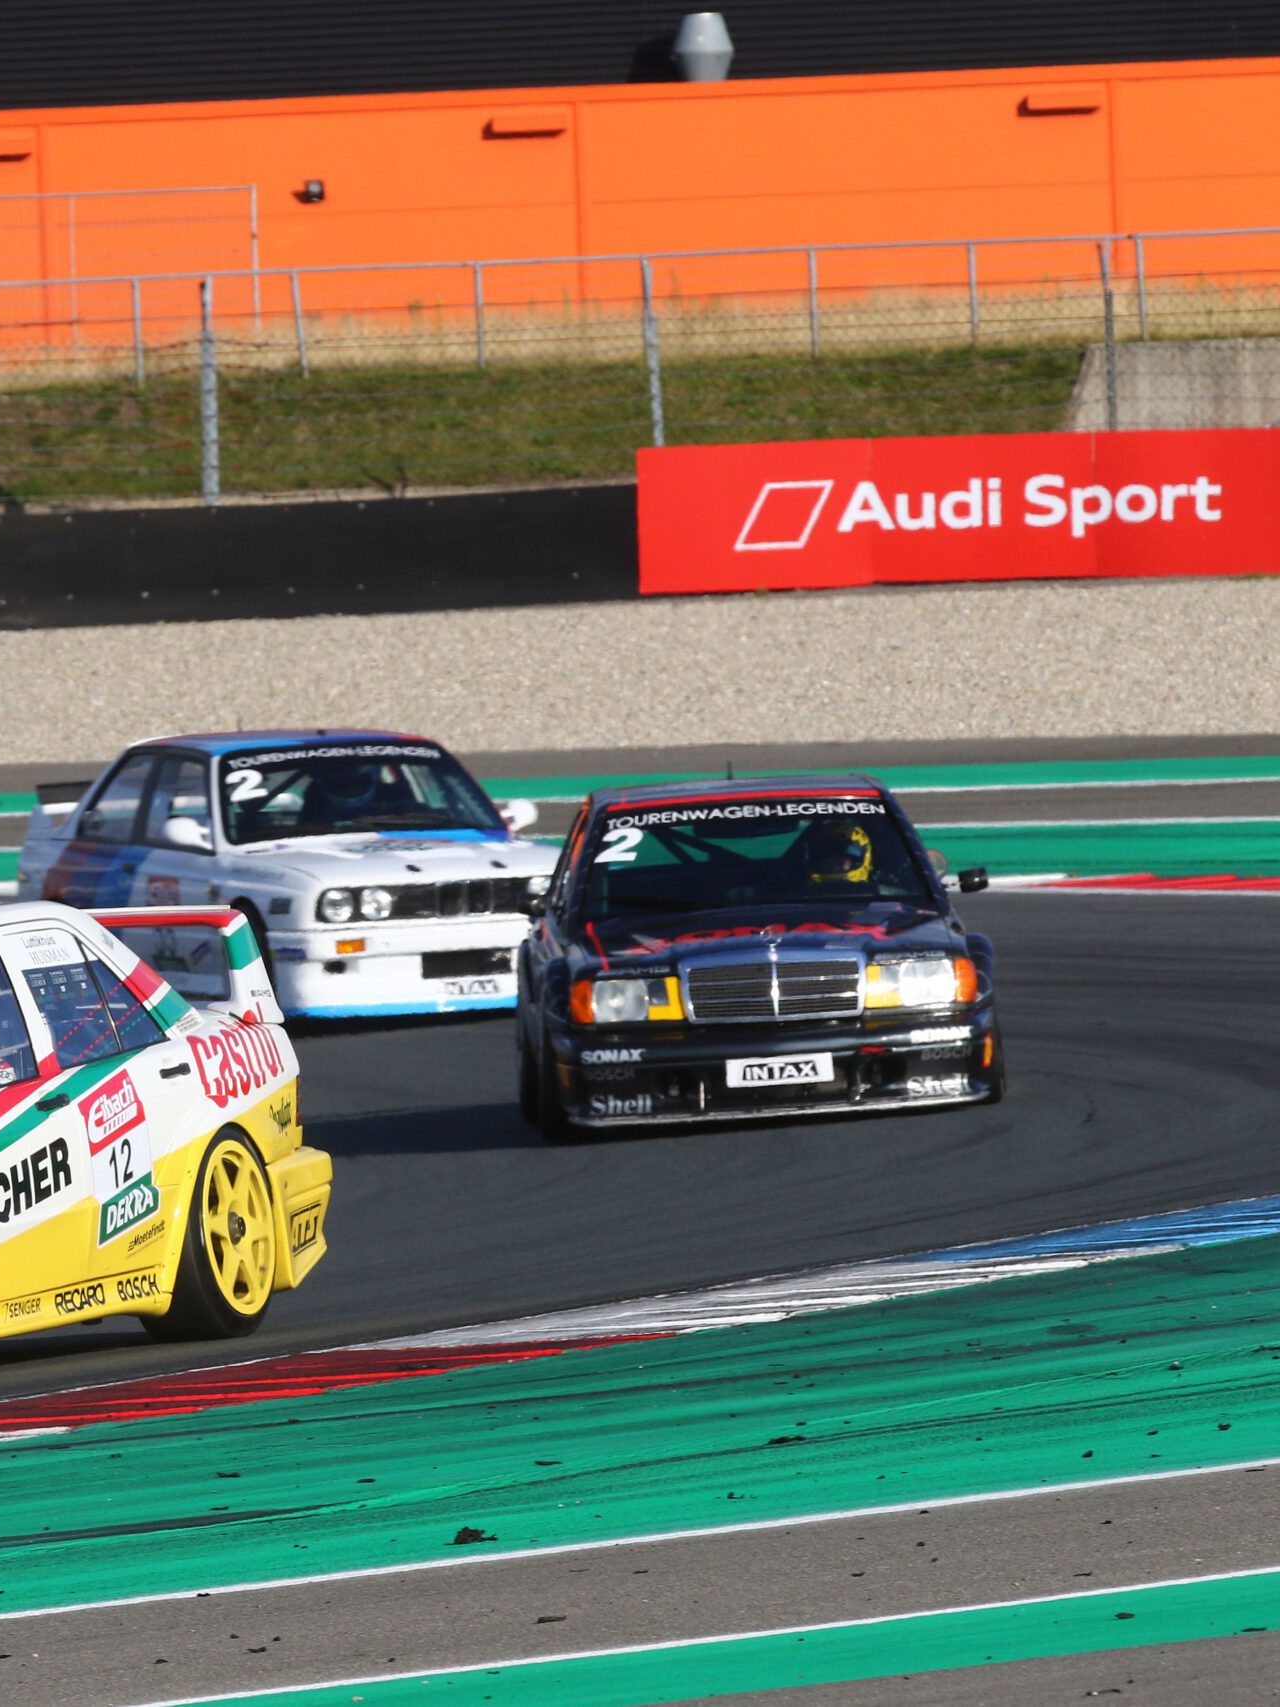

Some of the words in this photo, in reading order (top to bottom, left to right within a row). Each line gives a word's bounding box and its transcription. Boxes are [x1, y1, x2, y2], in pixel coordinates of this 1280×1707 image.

[837, 477, 1002, 533] Audi
[1024, 473, 1222, 538] Sport
[225, 769, 269, 803] 2
[607, 802, 885, 830] TOURENWAGEN-LEGENDEN
[594, 827, 644, 864] 2
[581, 1049, 644, 1065] SONAX
[745, 1062, 818, 1081] INTAX
[88, 1079, 136, 1144] Eibach
[590, 1094, 652, 1116] Shell
[109, 1138, 134, 1190] 12
[106, 1184, 154, 1235] DEKRA
[8, 1297, 42, 1319] SENGER
[54, 1282, 105, 1315] RECARO
[117, 1273, 161, 1301] BOSCH
